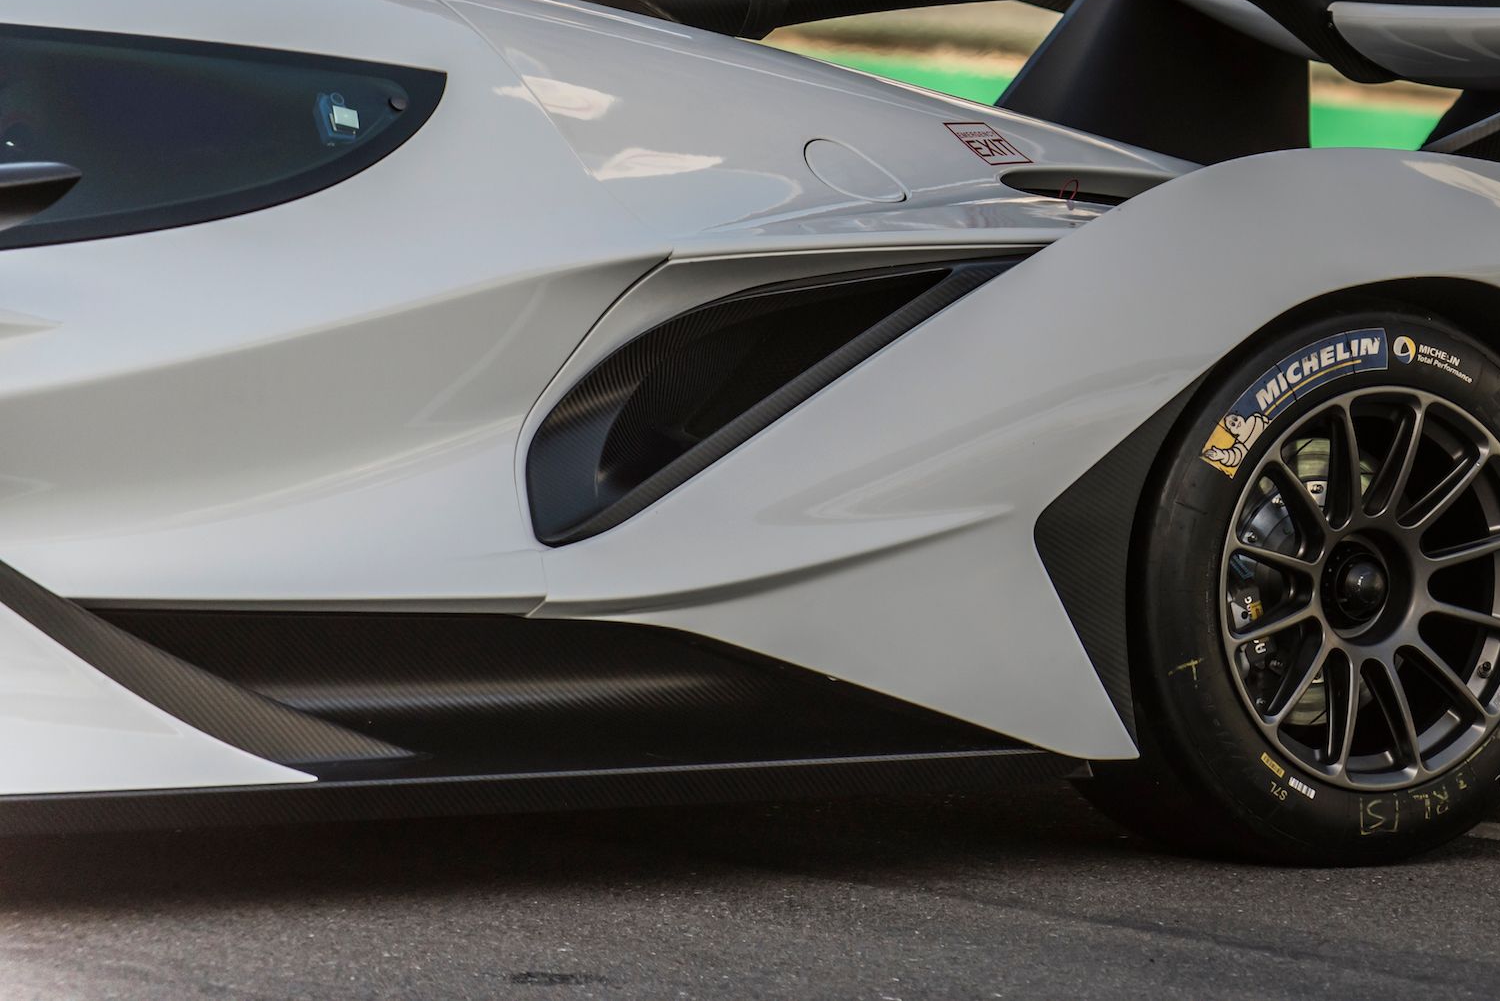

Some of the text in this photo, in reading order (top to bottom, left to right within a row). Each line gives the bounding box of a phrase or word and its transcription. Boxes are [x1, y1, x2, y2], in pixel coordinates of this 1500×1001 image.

[965, 138, 1016, 157] EXIT
[1255, 336, 1381, 411] MICHELIN
[1417, 354, 1473, 384] Total Performance
[1270, 780, 1288, 800] S7L
